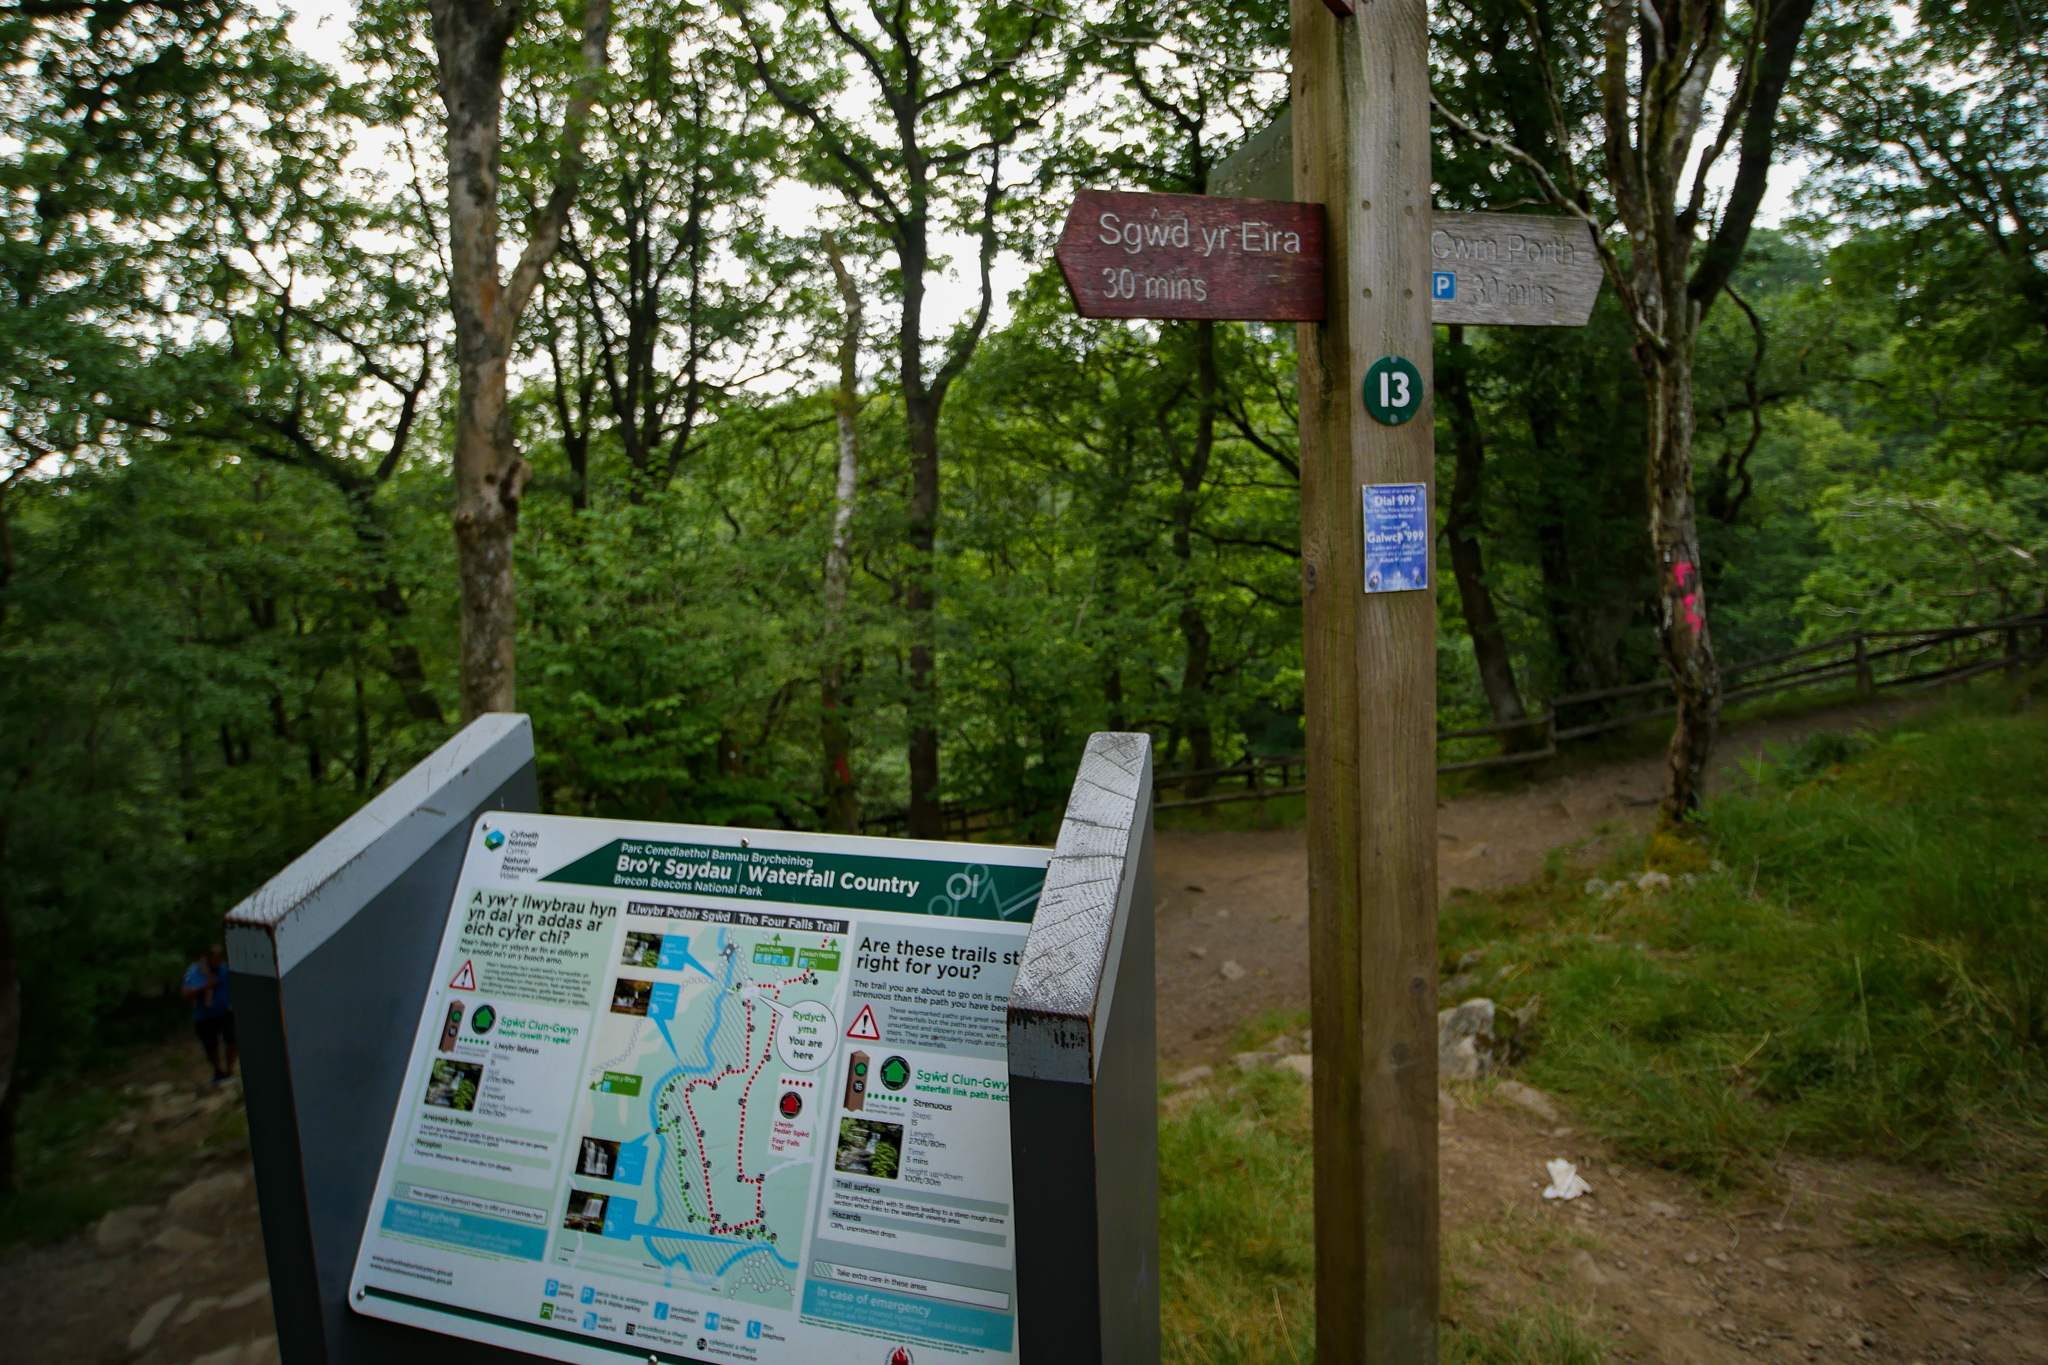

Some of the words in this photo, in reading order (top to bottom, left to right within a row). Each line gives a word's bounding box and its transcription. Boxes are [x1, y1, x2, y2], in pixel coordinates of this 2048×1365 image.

[1201, 225, 1230, 257] yr
[1242, 220, 1301, 254] Eira
[1431, 229, 1499, 262] Cwm
[1507, 233, 1576, 266] Porth
[1102, 267, 1136, 300] 30
[1145, 274, 1209, 301] mins
[1436, 275, 1451, 297] P
[1472, 273, 1500, 304] 30
[1506, 278, 1557, 306] mins
[1380, 371, 1411, 408] 13
[1374, 495, 1395, 507] Dial
[1397, 494, 1416, 506] 999
[1406, 530, 1425, 542] 999
[510, 830, 540, 841] Cyfoeth
[504, 856, 531, 865] Natural
[620, 842, 643, 855] Parc
[645, 844, 710, 860] Cenedlaethol
[711, 849, 749, 862] Bannau
[751, 852, 814, 868] Brycheiniog
[501, 864, 538, 874] Resources
[616, 854, 661, 875] Bro'r
[664, 858, 732, 881] Sgydau
[748, 864, 836, 889] Waterfall
[839, 872, 920, 898] Country
[613, 873, 649, 887] Brecon
[650, 876, 693, 891] Beacons
[694, 880, 737, 895] National
[739, 884, 763, 897] Park
[472, 891, 483, 905] A
[522, 894, 586, 915] llwybrau
[589, 901, 618, 918] hyn
[468, 908, 486, 922] yn
[490, 908, 513, 923] dal
[516, 912, 534, 928] yn
[538, 913, 583, 930] addas
[586, 918, 604, 932] ar
[629, 904, 665, 917] Llwybr
[666, 907, 700, 920] Pedair
[738, 913, 758, 926] The
[760, 915, 786, 929] Four
[787, 917, 814, 931] Falls
[816, 920, 841, 933] Trail
[464, 921, 494, 937] eich
[498, 924, 537, 942] cyfer
[539, 929, 570, 945] chi?
[859, 936, 891, 954] Are
[897, 940, 946, 959] these
[951, 945, 998, 964] trails
[857, 954, 899, 974] right
[905, 958, 932, 976] for
[937, 964, 982, 981] you?
[854, 979, 869, 989] The
[871, 981, 887, 991] trail
[889, 985, 904, 994] you
[905, 986, 919, 995] are
[921, 987, 945, 998] about
[947, 989, 957, 998] to
[958, 992, 970, 1000] go
[972, 992, 983, 1000] on
[985, 993, 993, 1001] is
[852, 990, 892, 1002] strenuous
[894, 993, 912, 1004] than
[914, 996, 928, 1005] the
[929, 997, 950, 1008] path
[951, 1002, 967, 1011] you
[968, 1001, 989, 1012] have
[991, 1003, 1008, 1013] bee
[792, 1010, 827, 1023] Rydych
[899, 1015, 927, 1024] waterfalls
[908, 1009, 941, 1019] waymarked
[942, 1012, 959, 1020] paths
[960, 1014, 973, 1022] give
[797, 1026, 817, 1035] yma
[887, 1022, 920, 1031] unsurfaced
[933, 1027, 956, 1035] slippery
[789, 1035, 805, 1047] You
[808, 1040, 824, 1048] are
[905, 1031, 918, 1039] They
[965, 1038, 983, 1046] rough
[793, 1049, 814, 1060] here
[952, 1073, 1009, 1092] Clun-Gwy
[915, 1084, 950, 1096] waterfall
[953, 1087, 967, 1097] link
[970, 1089, 989, 1100] path
[913, 1099, 953, 1111] Strenuous
[772, 1137, 785, 1145] Four
[908, 1138, 946, 1149] 270ft/80m
[912, 1157, 929, 1166] mins
[905, 1167, 928, 1177] Height
[836, 1180, 852, 1189] Trail
[854, 1183, 881, 1194] surface
[904, 1175, 942, 1187] 100ft/30m
[832, 1210, 862, 1222] Hazards
[846, 1225, 879, 1236] unprotected
[836, 1268, 850, 1278] Take
[852, 1272, 868, 1281] extra
[869, 1275, 883, 1284] care
[884, 1276, 891, 1284] in
[892, 1278, 909, 1288] these
[910, 1282, 928, 1291] areas
[816, 1286, 828, 1297] In
[829, 1290, 854, 1303] case
[856, 1294, 869, 1304] of
[870, 1298, 931, 1318] emergency
